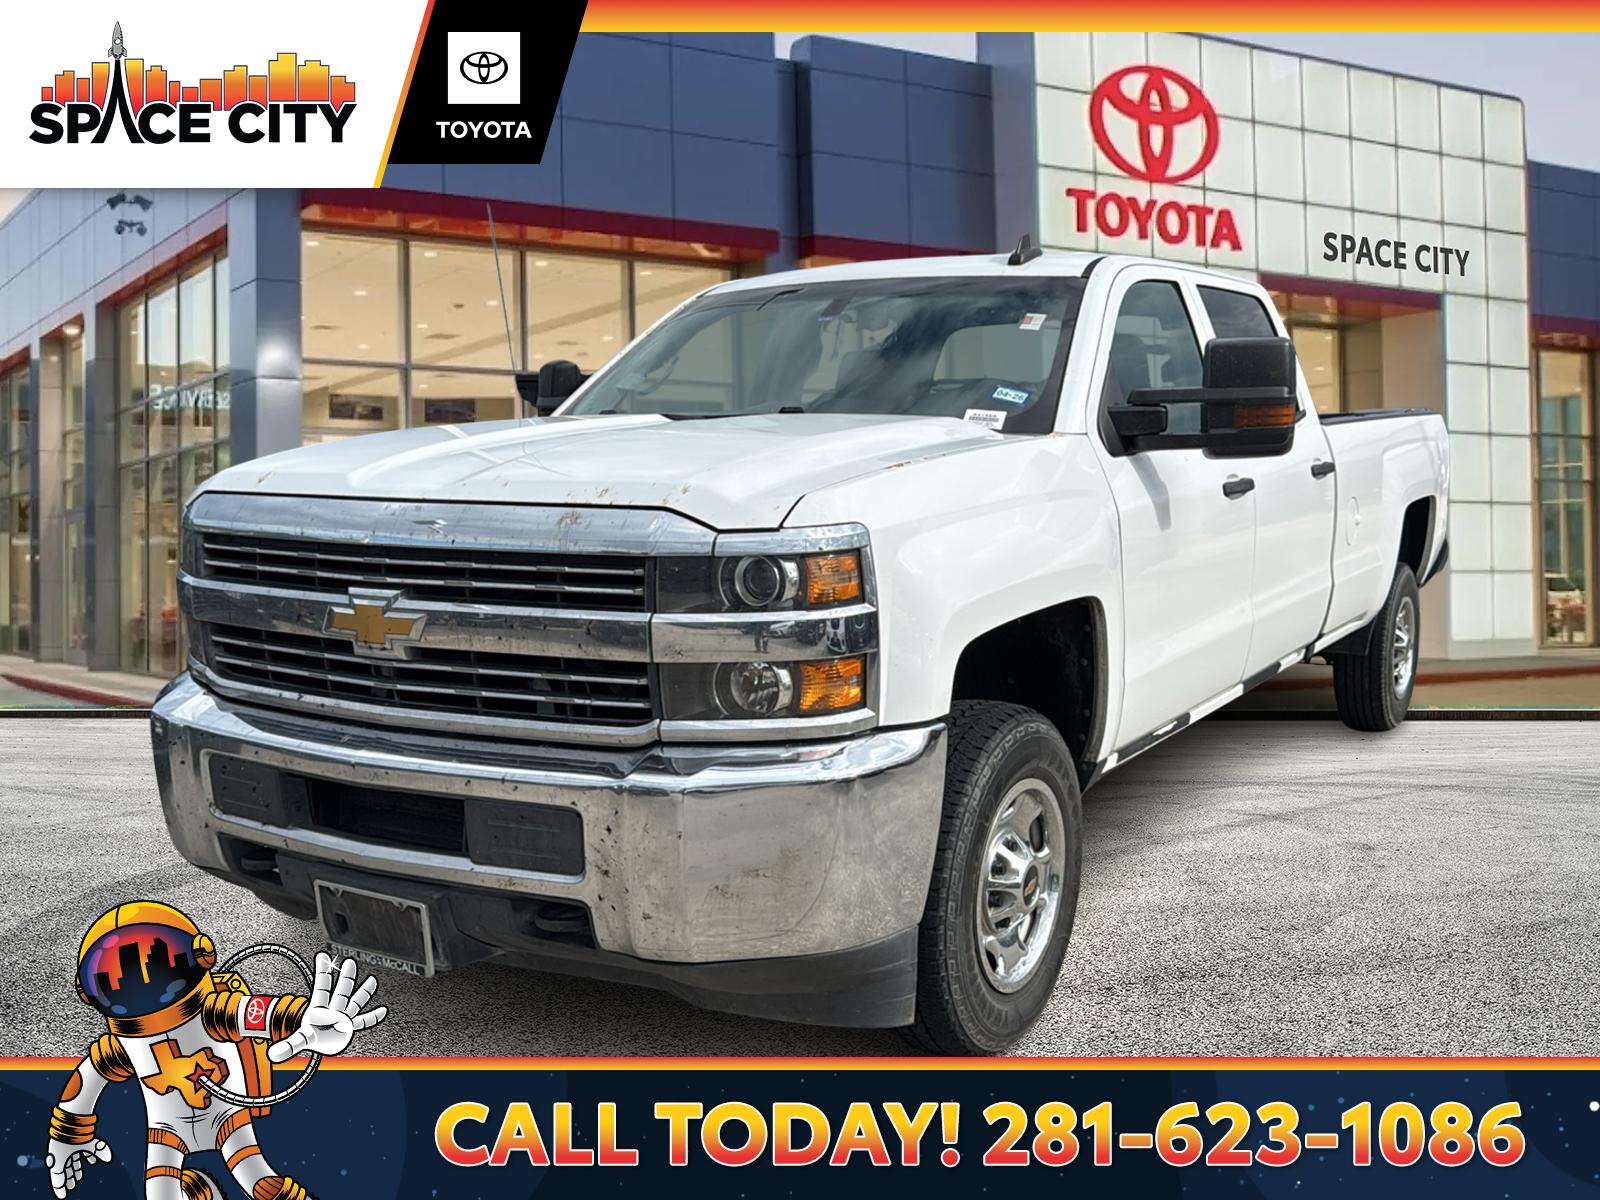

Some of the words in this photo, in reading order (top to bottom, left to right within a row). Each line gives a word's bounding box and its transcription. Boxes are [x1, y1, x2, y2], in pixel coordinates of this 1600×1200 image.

[1066, 187, 1242, 251] TOYOTA
[1323, 231, 1407, 270] SPACE
[1414, 244, 1470, 277] CITY
[330, 943, 377, 965] STERLING
